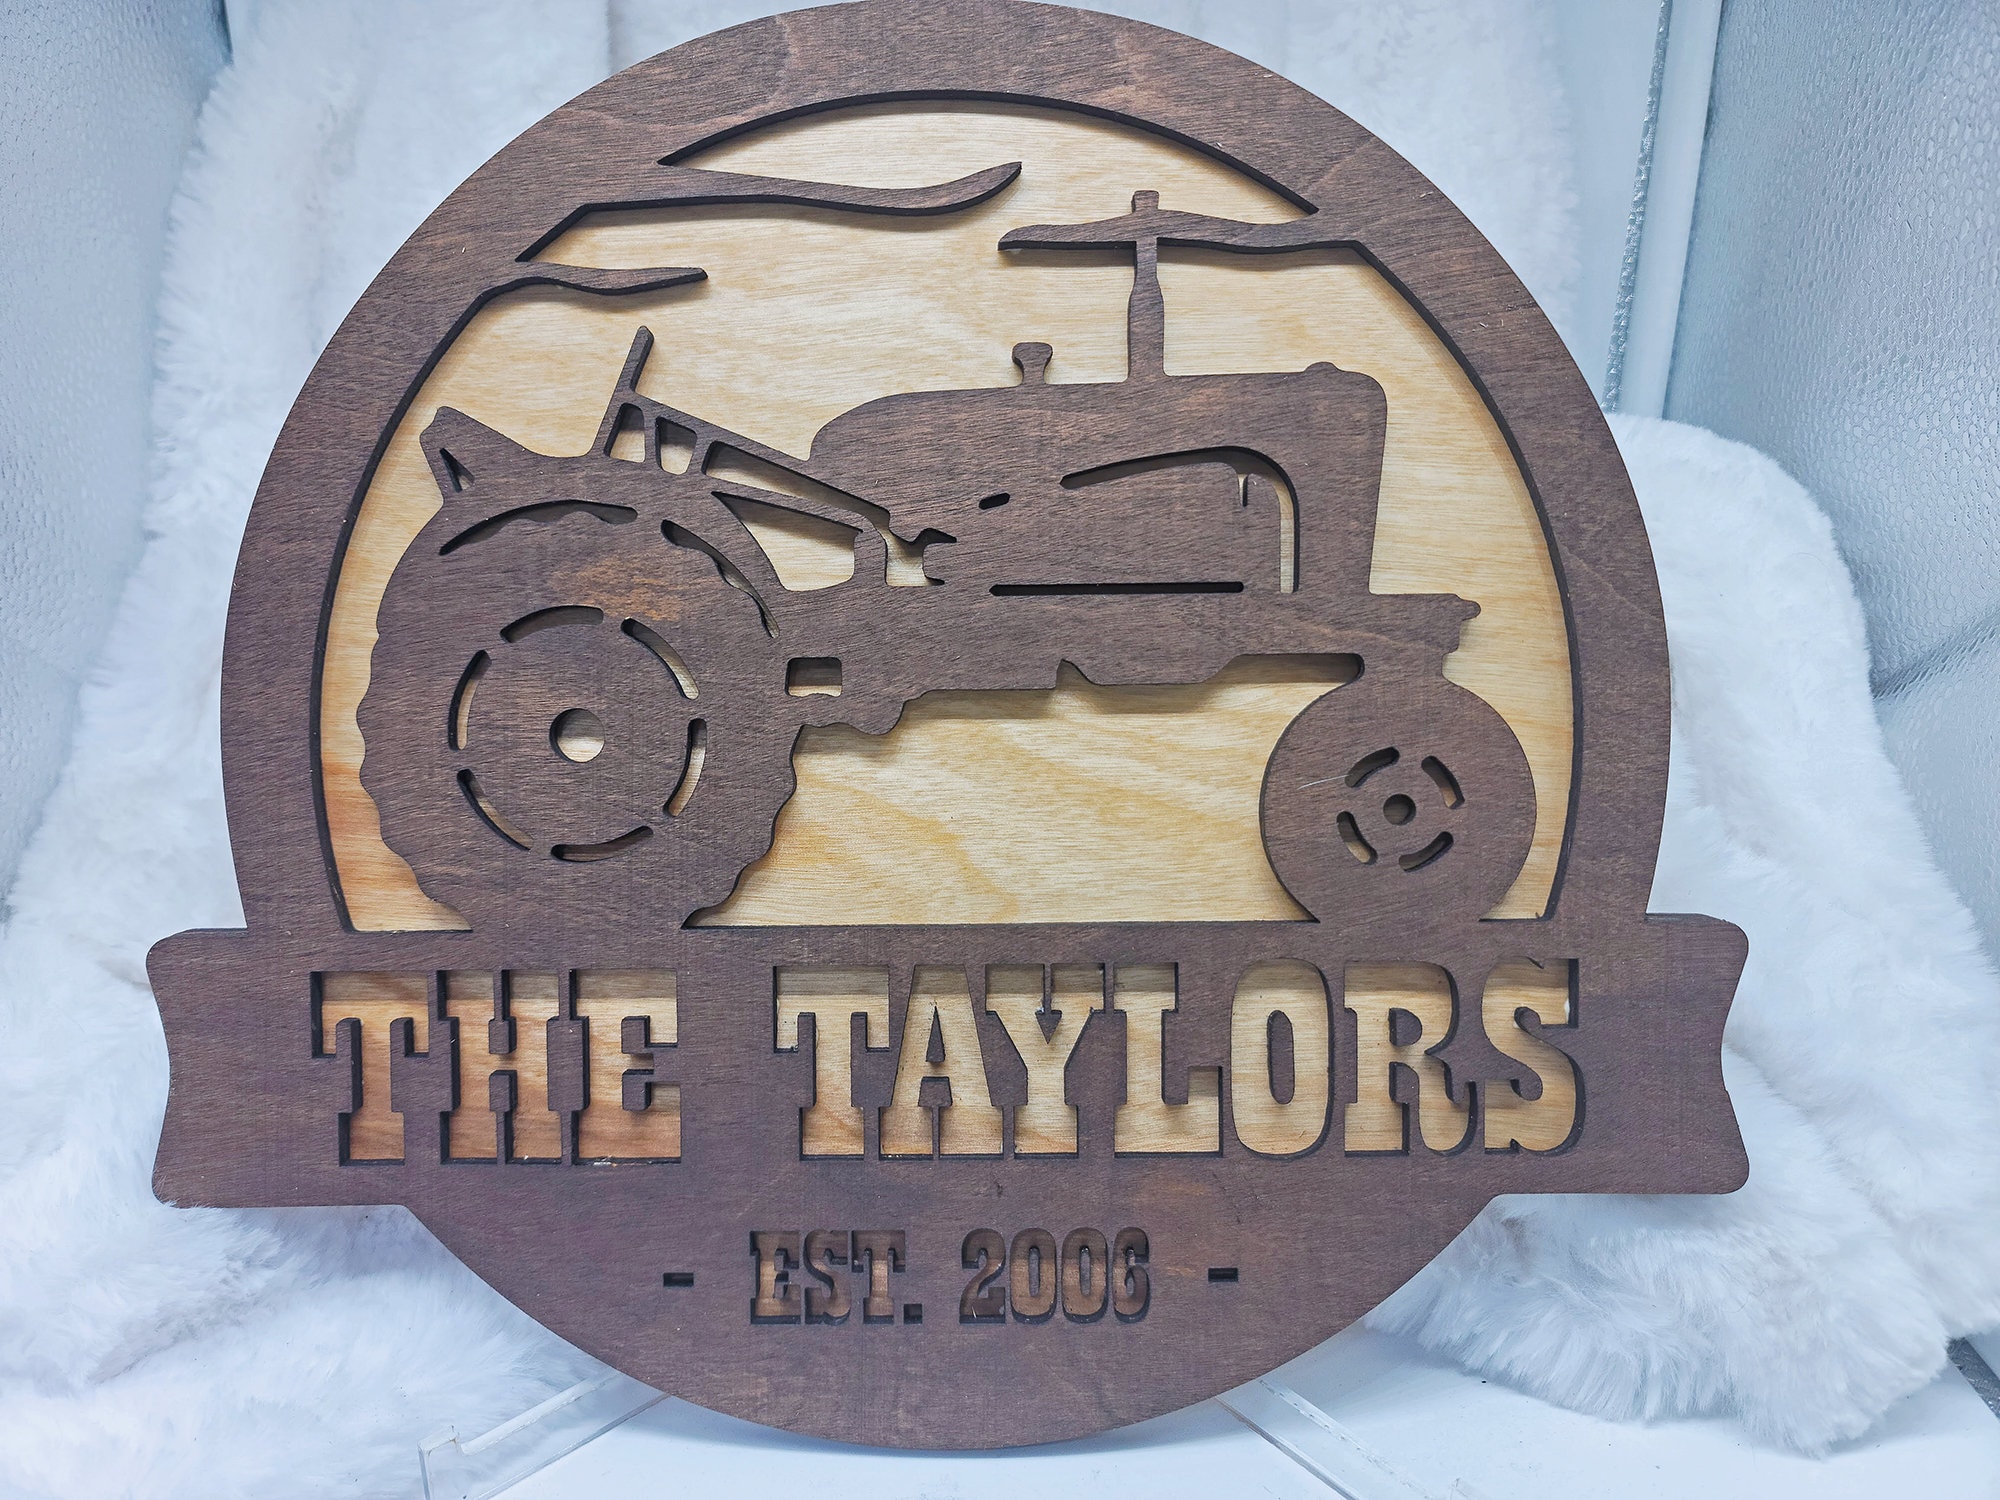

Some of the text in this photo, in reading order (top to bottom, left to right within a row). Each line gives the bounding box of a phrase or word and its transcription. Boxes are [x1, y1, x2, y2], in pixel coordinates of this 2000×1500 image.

[310, 957, 1584, 1167] THE TAYLORS
[750, 1229, 922, 1325] EST.
[959, 1227, 1150, 1324] 2006
